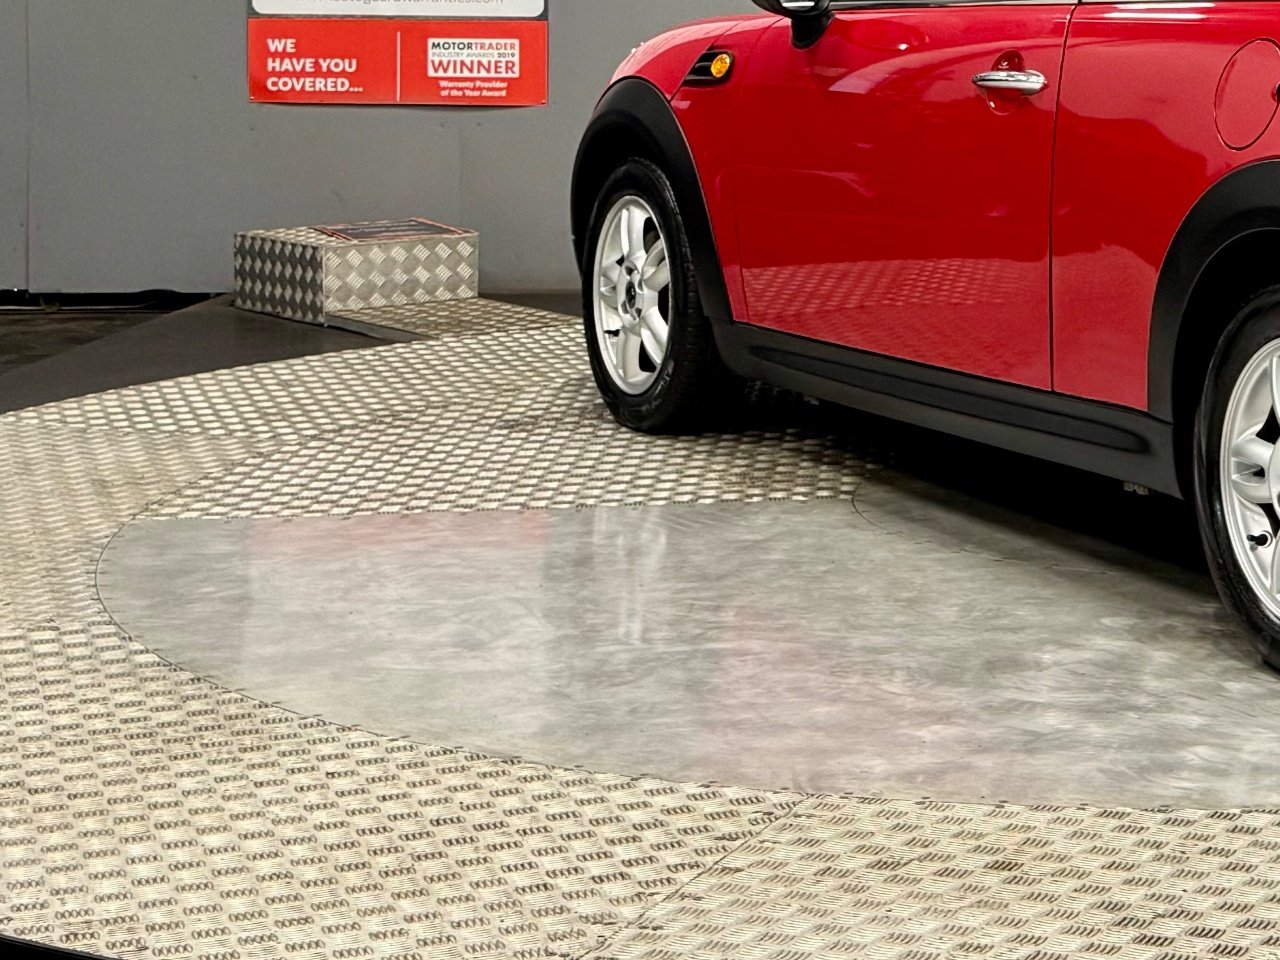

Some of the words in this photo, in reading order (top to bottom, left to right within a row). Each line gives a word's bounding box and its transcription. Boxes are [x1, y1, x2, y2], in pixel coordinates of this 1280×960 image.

[266, 38, 296, 53] WE
[431, 41, 516, 51] MOTORTRADER
[266, 58, 315, 72] HAVE
[318, 58, 357, 73] YOU
[431, 59, 516, 75] WINNER
[266, 77, 363, 92] COVERED...
[439, 81, 474, 89] Warranty
[450, 89, 463, 97] the
